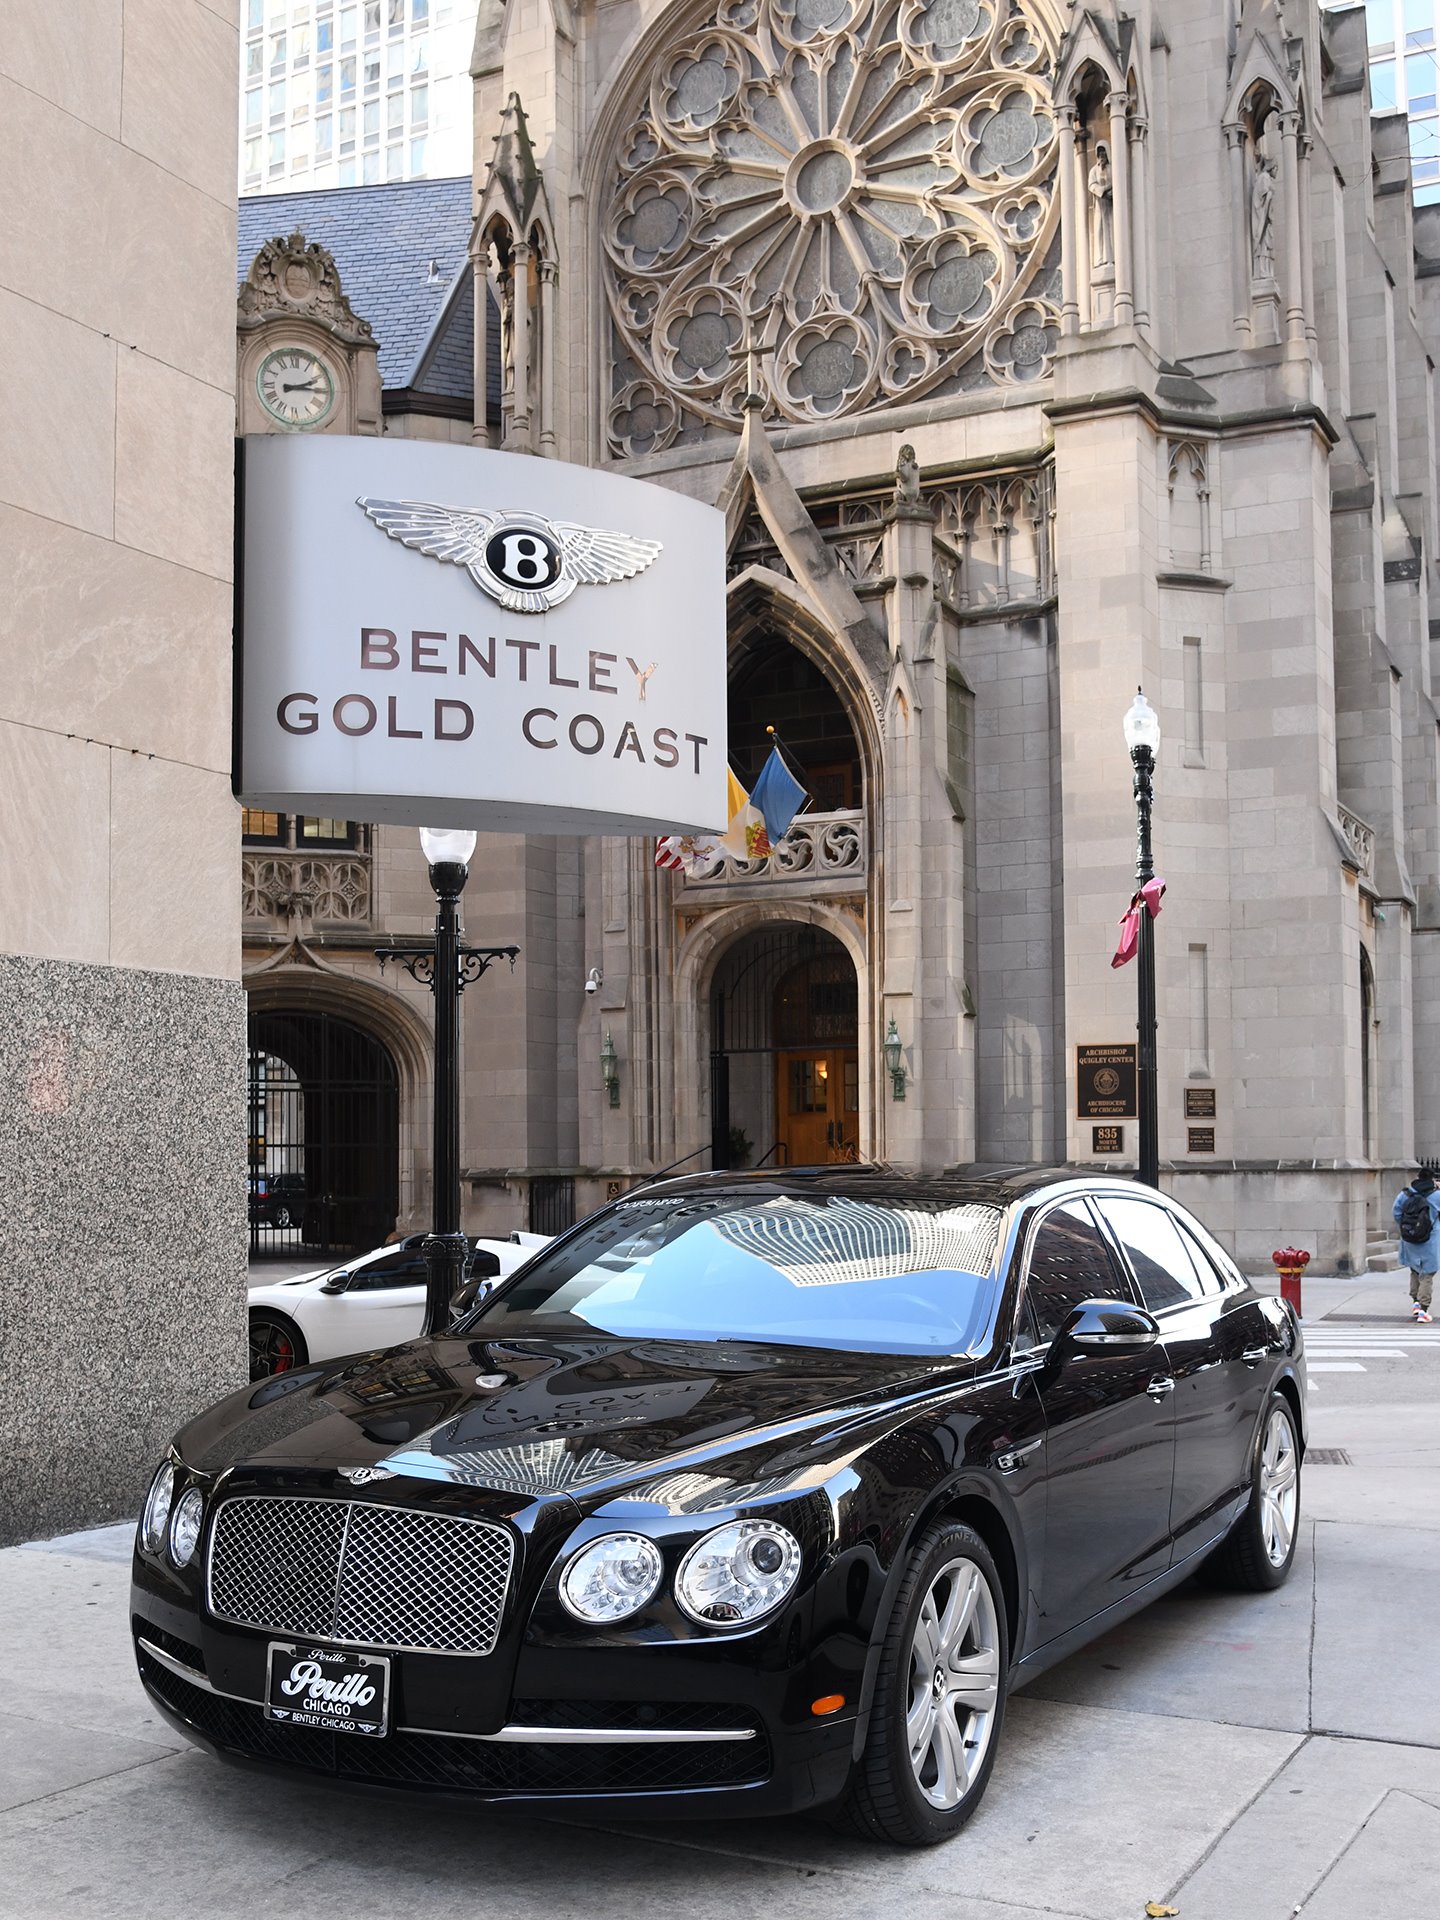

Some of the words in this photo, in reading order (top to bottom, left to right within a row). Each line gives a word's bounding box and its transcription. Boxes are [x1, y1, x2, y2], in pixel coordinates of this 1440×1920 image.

[500, 533, 551, 583] B
[360, 626, 660, 702] BENTLEY
[276, 692, 475, 742] GOLD
[521, 706, 709, 775] COAST
[1078, 1057, 1108, 1065] QUIGLEY
[1108, 1056, 1135, 1064] CENTER
[1085, 1048, 1128, 1056] ARCHBISHOP
[1097, 1127, 1118, 1139] 835
[307, 1649, 347, 1663] Perillo
[280, 1660, 376, 1707] Perillo
[302, 1698, 351, 1717] CHICAGO
[292, 1712, 320, 1725] BENTLEY
[321, 1717, 356, 1731] CHICAGO
